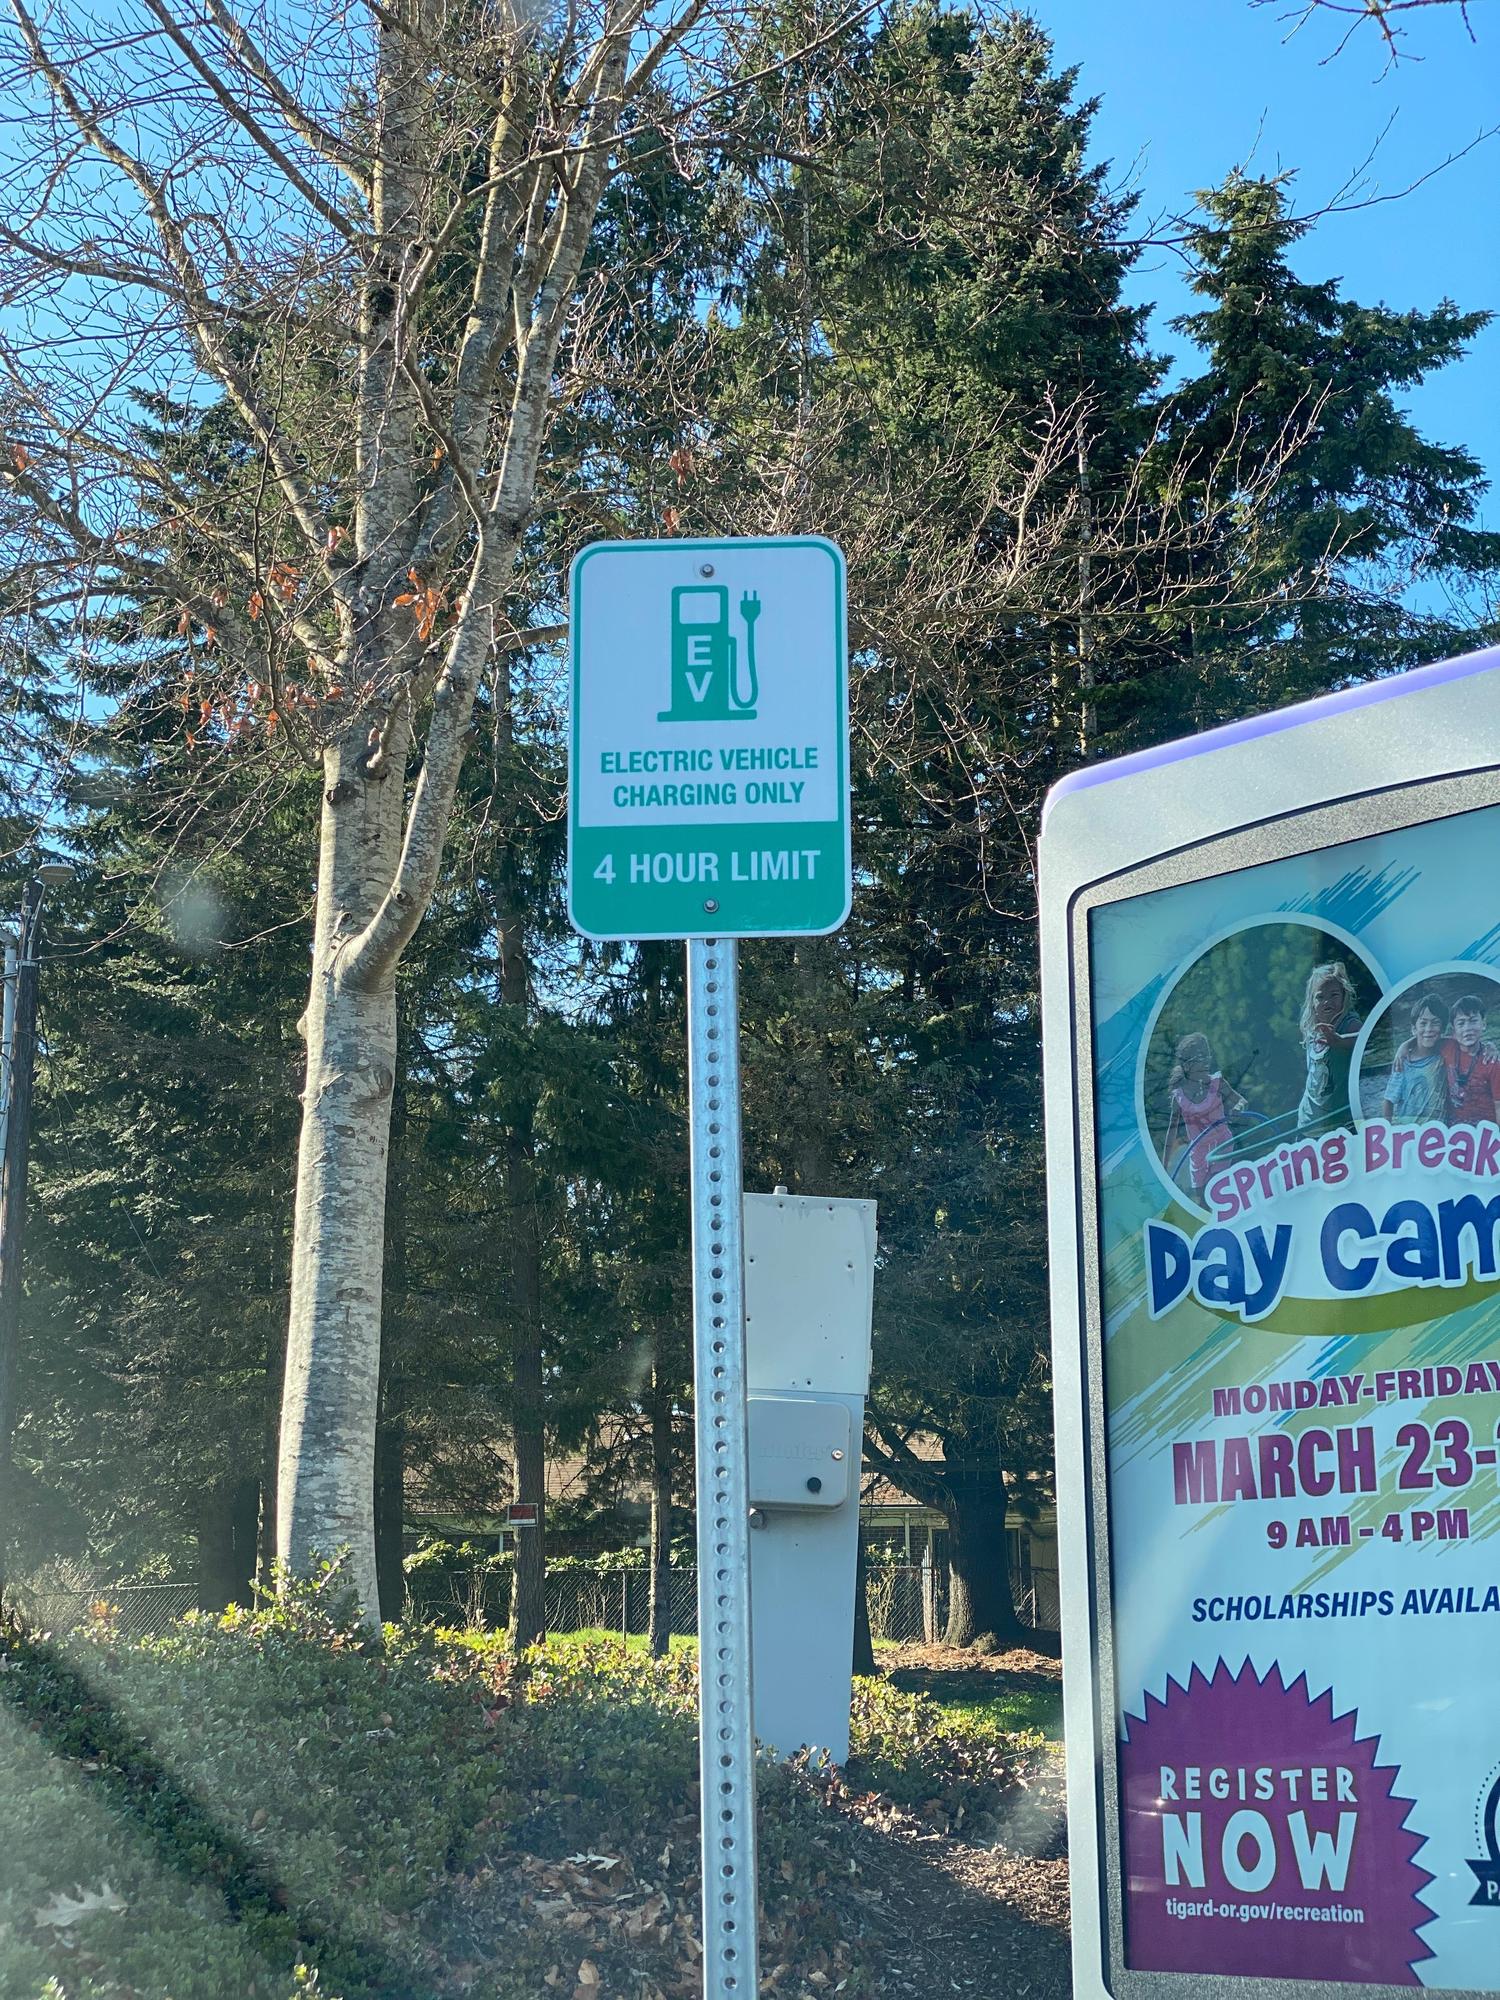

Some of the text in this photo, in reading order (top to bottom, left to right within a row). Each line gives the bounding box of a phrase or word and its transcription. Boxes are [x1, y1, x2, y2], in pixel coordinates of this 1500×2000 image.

[600, 747, 818, 774] ELECTRIC VEHICLE
[613, 781, 806, 808] CHARGING ONLY
[593, 849, 821, 884] 4 HOUR LIMIT
[1364, 1124, 1500, 1177] Break
[1148, 1223, 1293, 1316] Day
[1172, 1419, 1500, 1505] MARCH 23-
[1267, 1521, 1288, 1549] 9
[1295, 1516, 1351, 1548] AM
[1381, 1514, 1404, 1543] 4
[1411, 1508, 1469, 1541] PM
[1191, 1585, 1500, 1622] SCHOLARSHIPS AVAILA
[1160, 1766, 1358, 1802] REGISTER
[1162, 1809, 1358, 1892] NOW
[1165, 1898, 1365, 1924] tigard-or.gov/recreation
